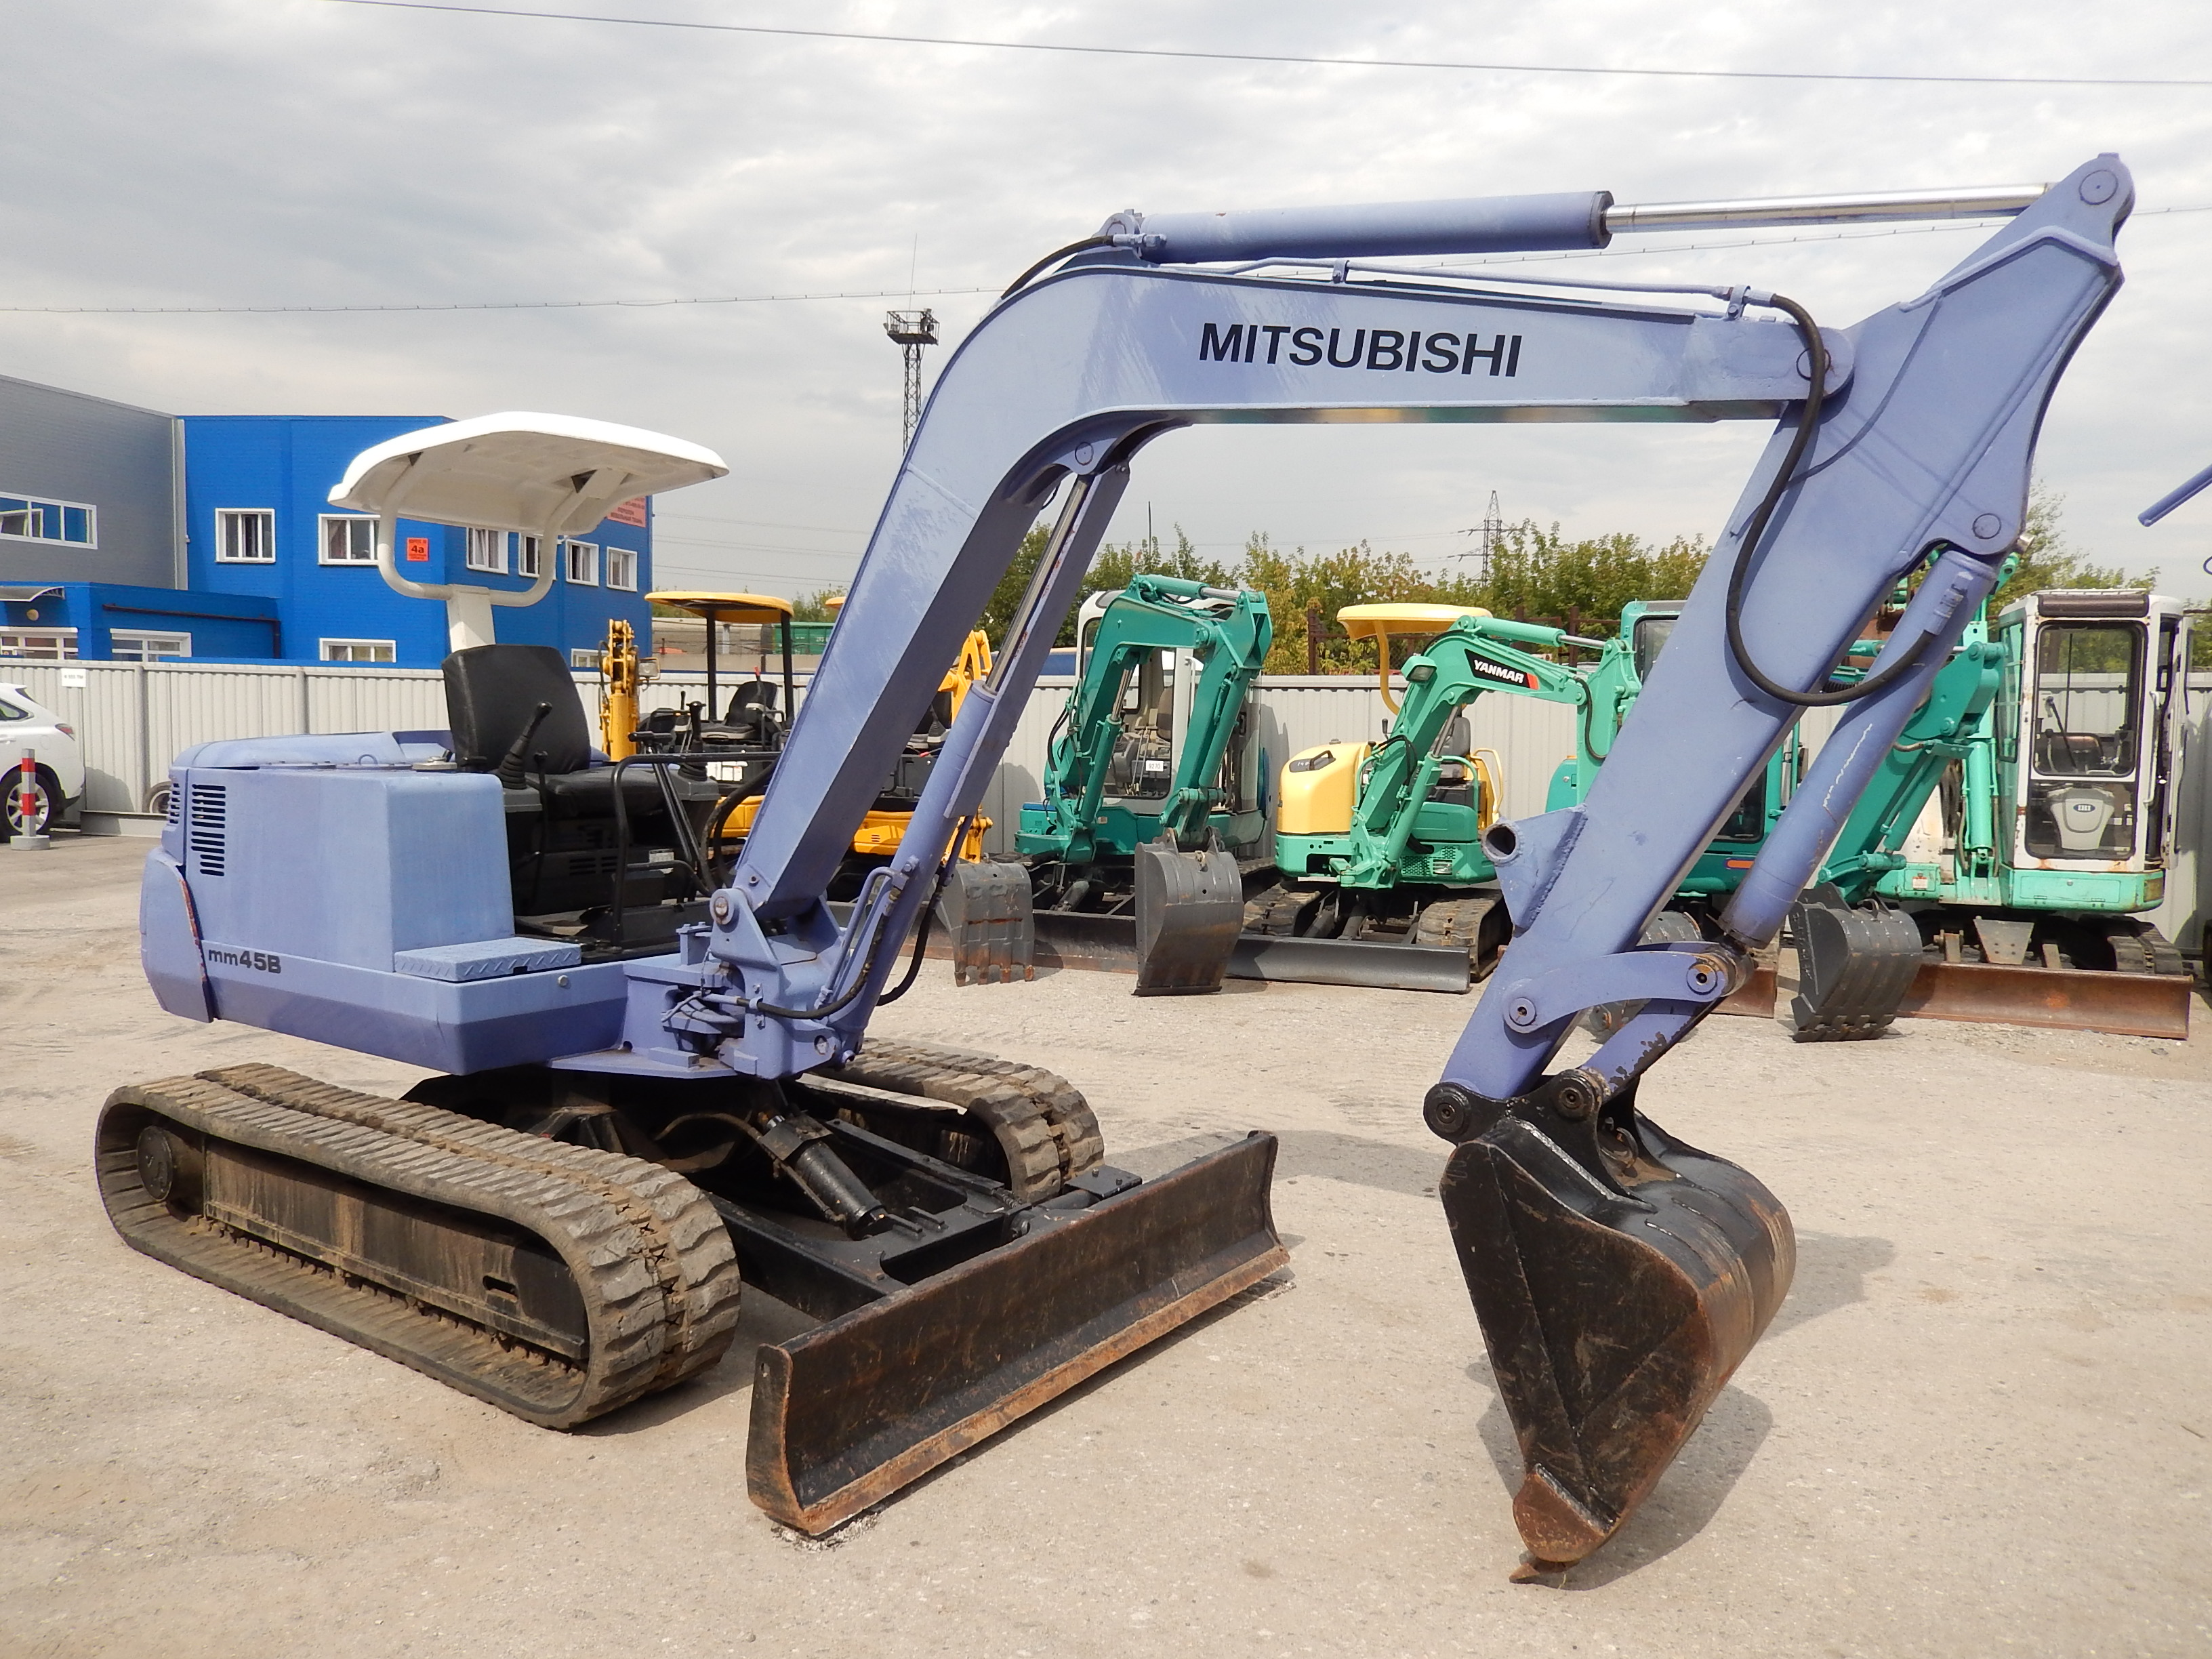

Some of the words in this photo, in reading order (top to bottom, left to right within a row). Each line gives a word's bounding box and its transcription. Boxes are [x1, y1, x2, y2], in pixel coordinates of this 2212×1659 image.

[1199, 323, 1522, 377] MITSUBISHI
[1473, 659, 1525, 684] YANMAR
[208, 949, 282, 974] mm45B
